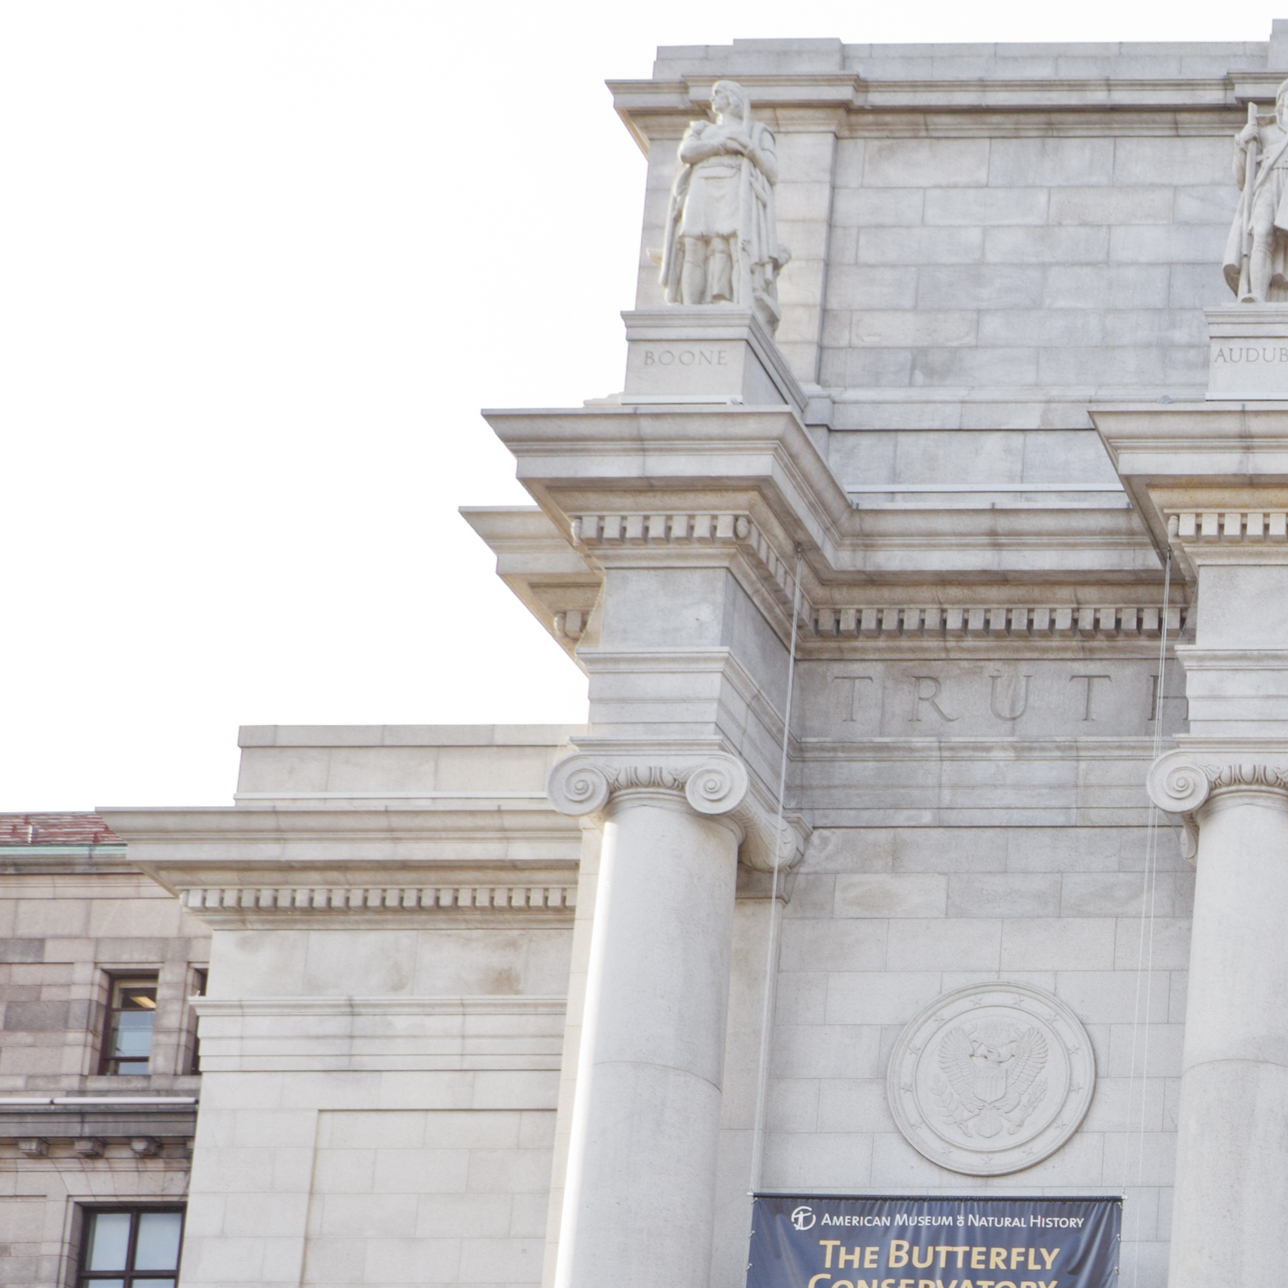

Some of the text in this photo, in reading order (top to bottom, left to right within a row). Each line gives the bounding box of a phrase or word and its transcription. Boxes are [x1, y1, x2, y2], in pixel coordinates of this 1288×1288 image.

[643, 350, 728, 366] BOONE
[821, 1213, 891, 1227] AMERICAN
[894, 1213, 953, 1227] MUSEUM
[968, 1214, 1027, 1228] NATURAL
[1030, 1215, 1085, 1228] HISTORY
[819, 1239, 1060, 1270] THE BUTTERFLY
